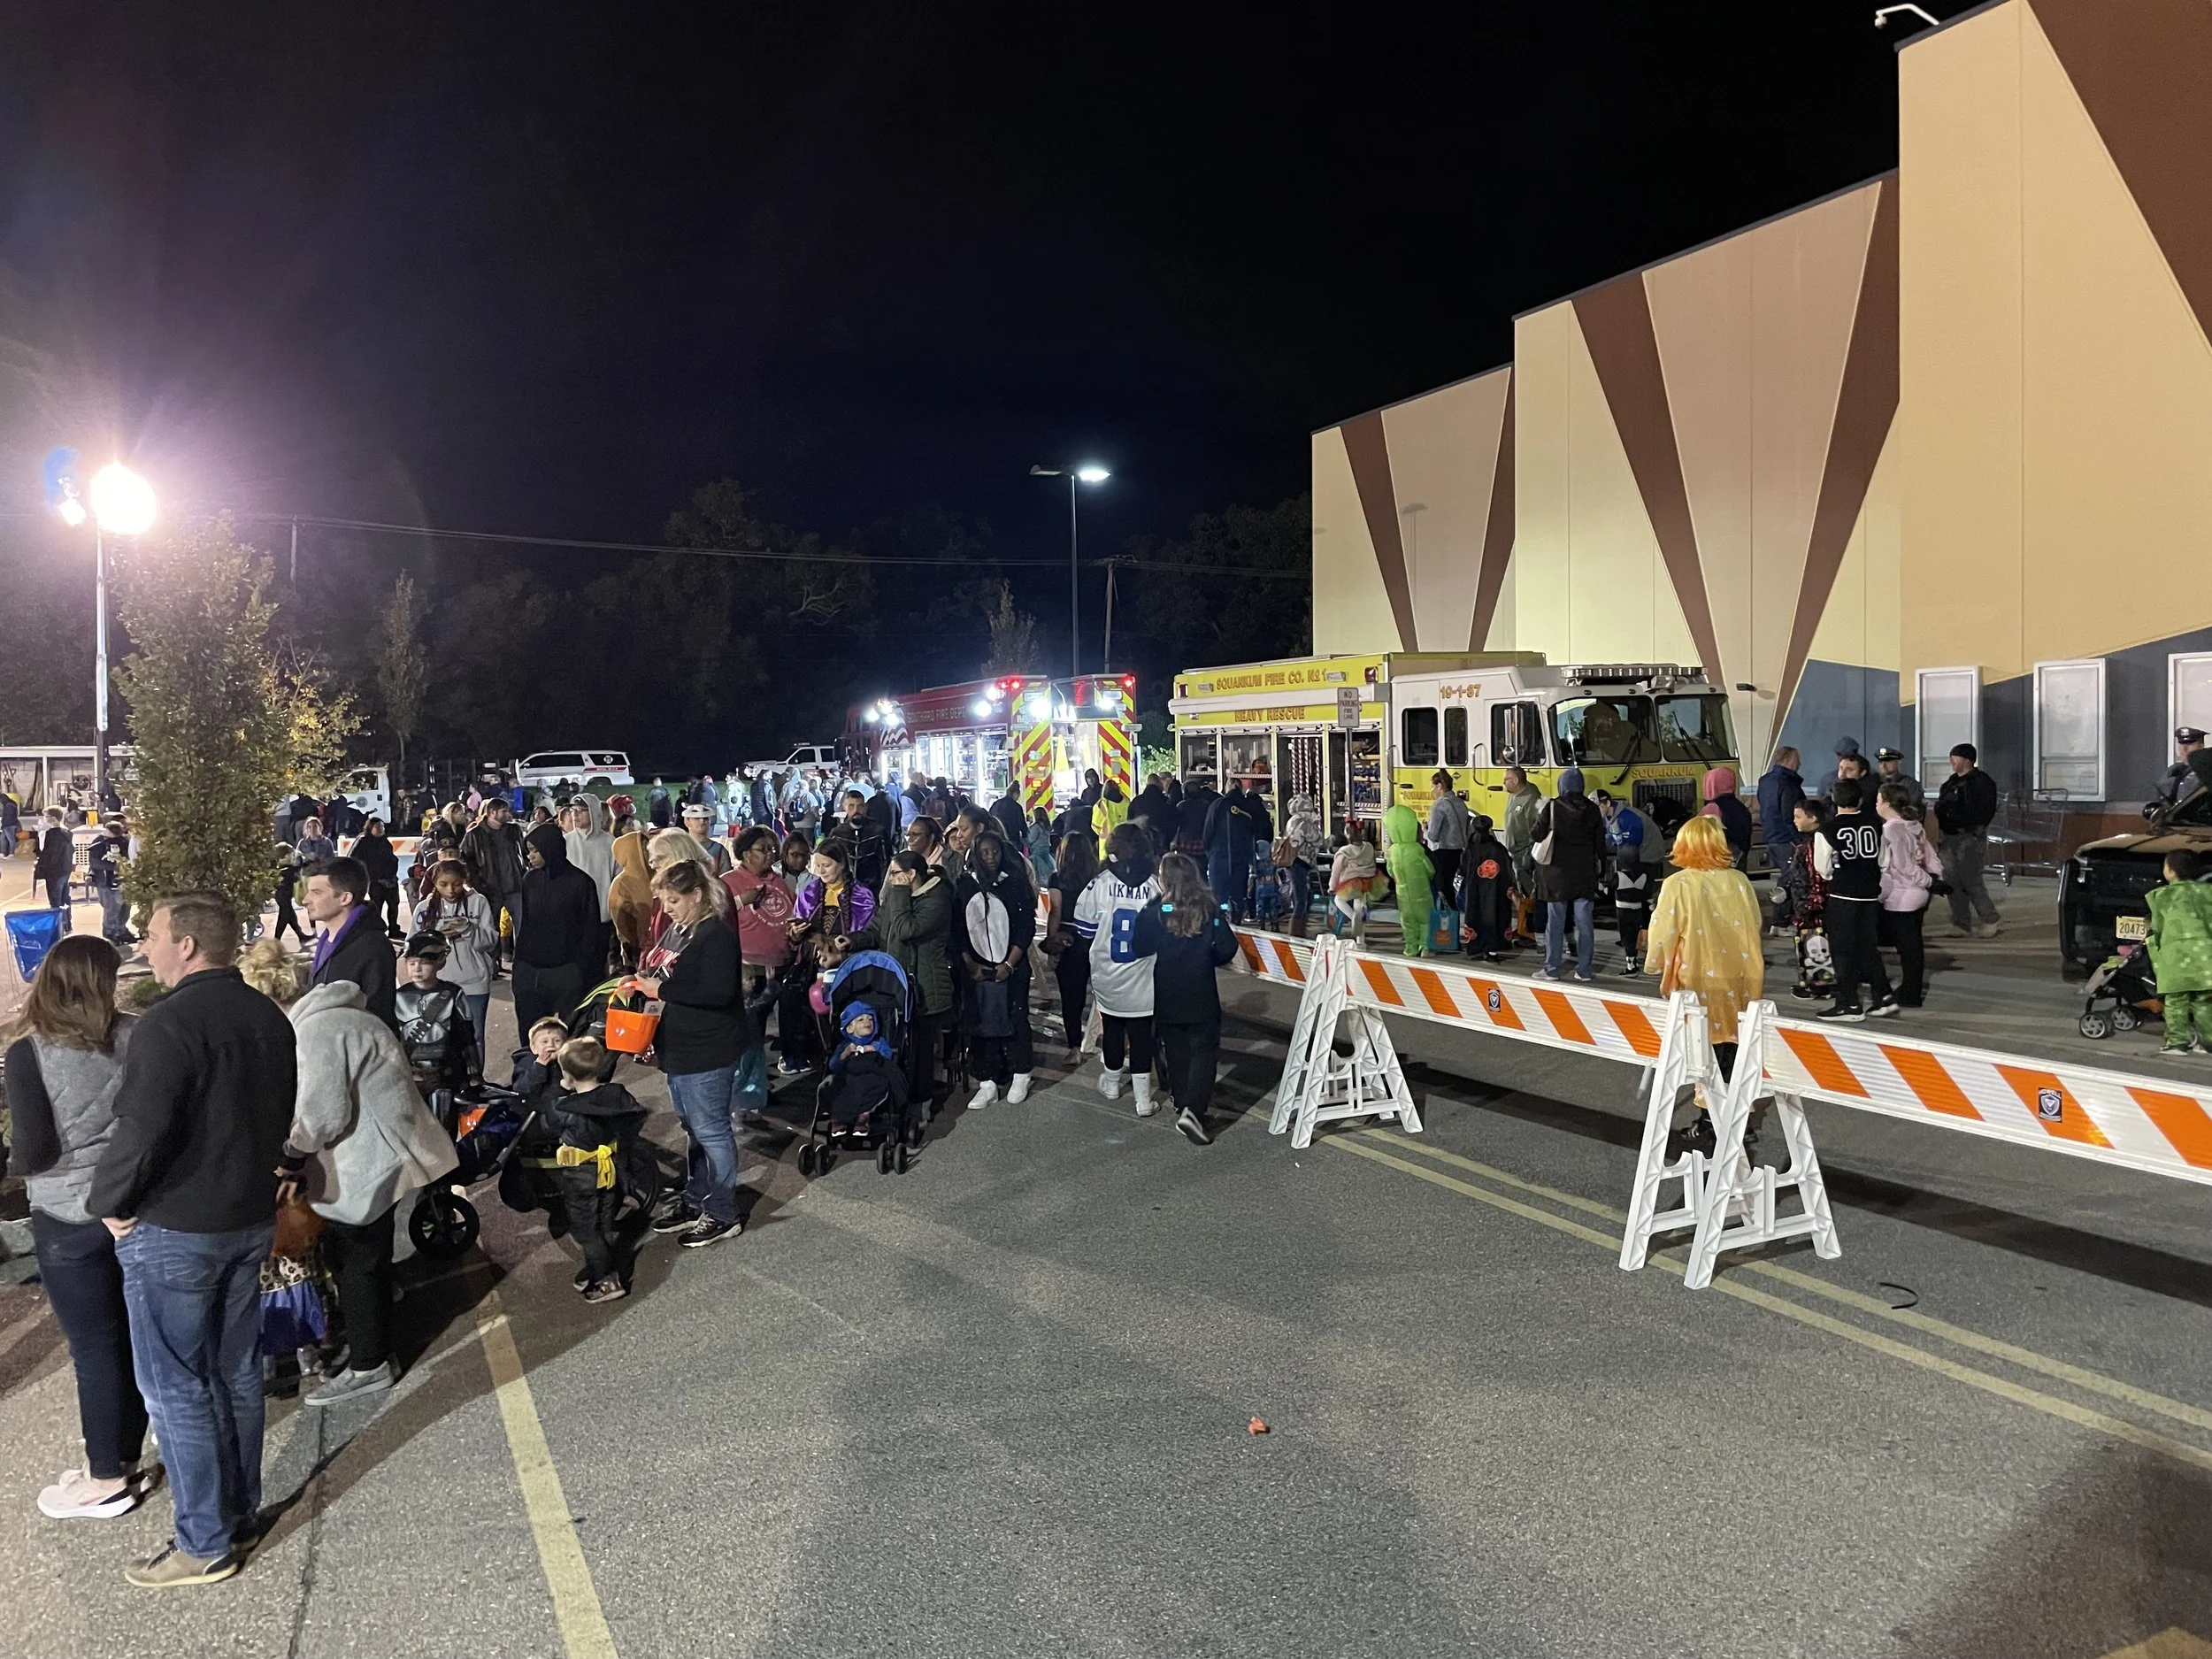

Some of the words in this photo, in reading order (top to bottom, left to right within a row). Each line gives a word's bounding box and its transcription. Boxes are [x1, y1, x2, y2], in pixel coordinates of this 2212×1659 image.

[1264, 672, 1285, 686] FIRE
[1343, 690, 1353, 699] NO
[935, 707, 949, 721] FIRE
[1234, 708, 1264, 722] HEAVY
[1267, 706, 1305, 721] RESCUE
[1837, 826, 1878, 859] 30
[1110, 908, 1139, 963] 8
